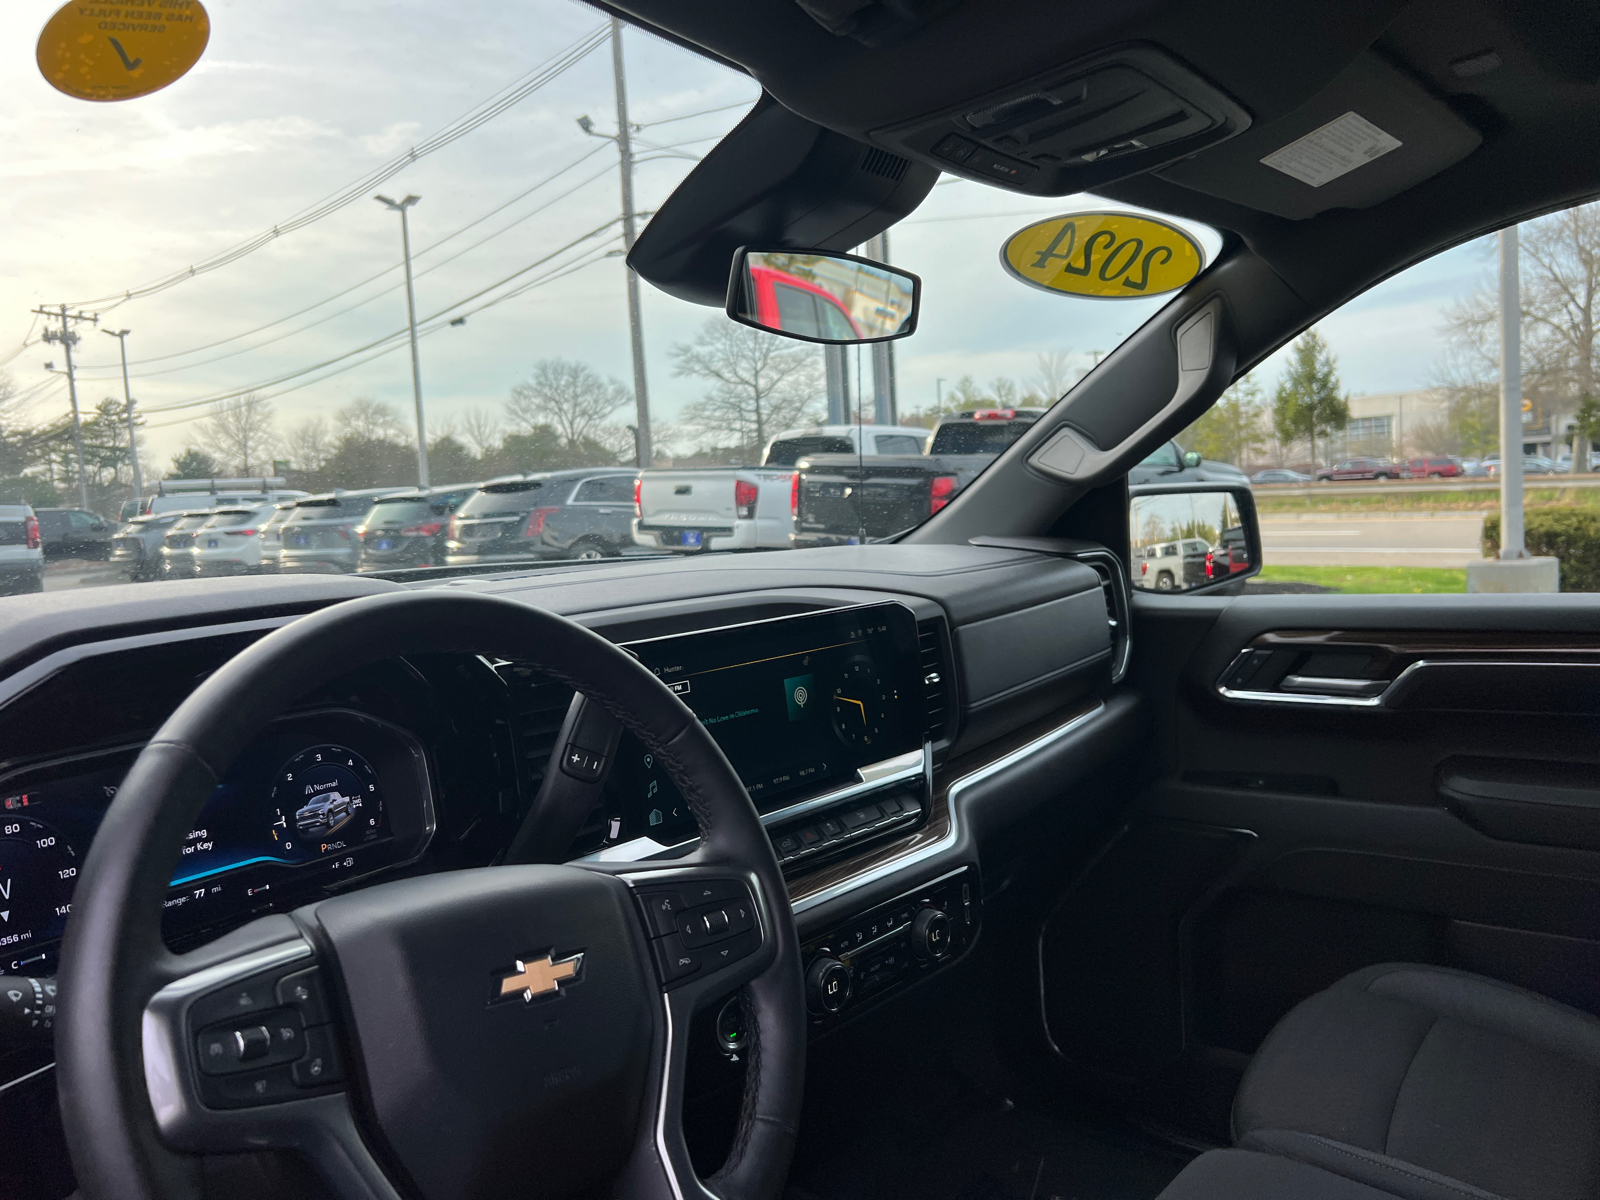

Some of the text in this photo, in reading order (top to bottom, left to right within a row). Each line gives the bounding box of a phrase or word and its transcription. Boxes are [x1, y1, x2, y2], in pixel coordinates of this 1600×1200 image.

[734, 708, 759, 718] Oklahoma
[315, 753, 322, 762] 3
[347, 758, 354, 766] 4
[286, 773, 293, 781] 2
[314, 779, 339, 792] Normal
[368, 784, 375, 792] 5
[275, 808, 281, 816] 1
[369, 818, 376, 826] 6
[4, 823, 21, 835] 80
[185, 829, 207, 840] sing
[36, 836, 56, 849] 100
[196, 841, 214, 852] Key
[285, 841, 292, 850] 0
[321, 841, 347, 853] PRNDL
[335, 861, 340, 869] F
[58, 867, 77, 880] 120
[194, 888, 205, 899] 77
[211, 884, 222, 893] mi
[247, 888, 254, 896] E
[0, 929, 32, 947] 356 mi
[11, 960, 19, 970] C
